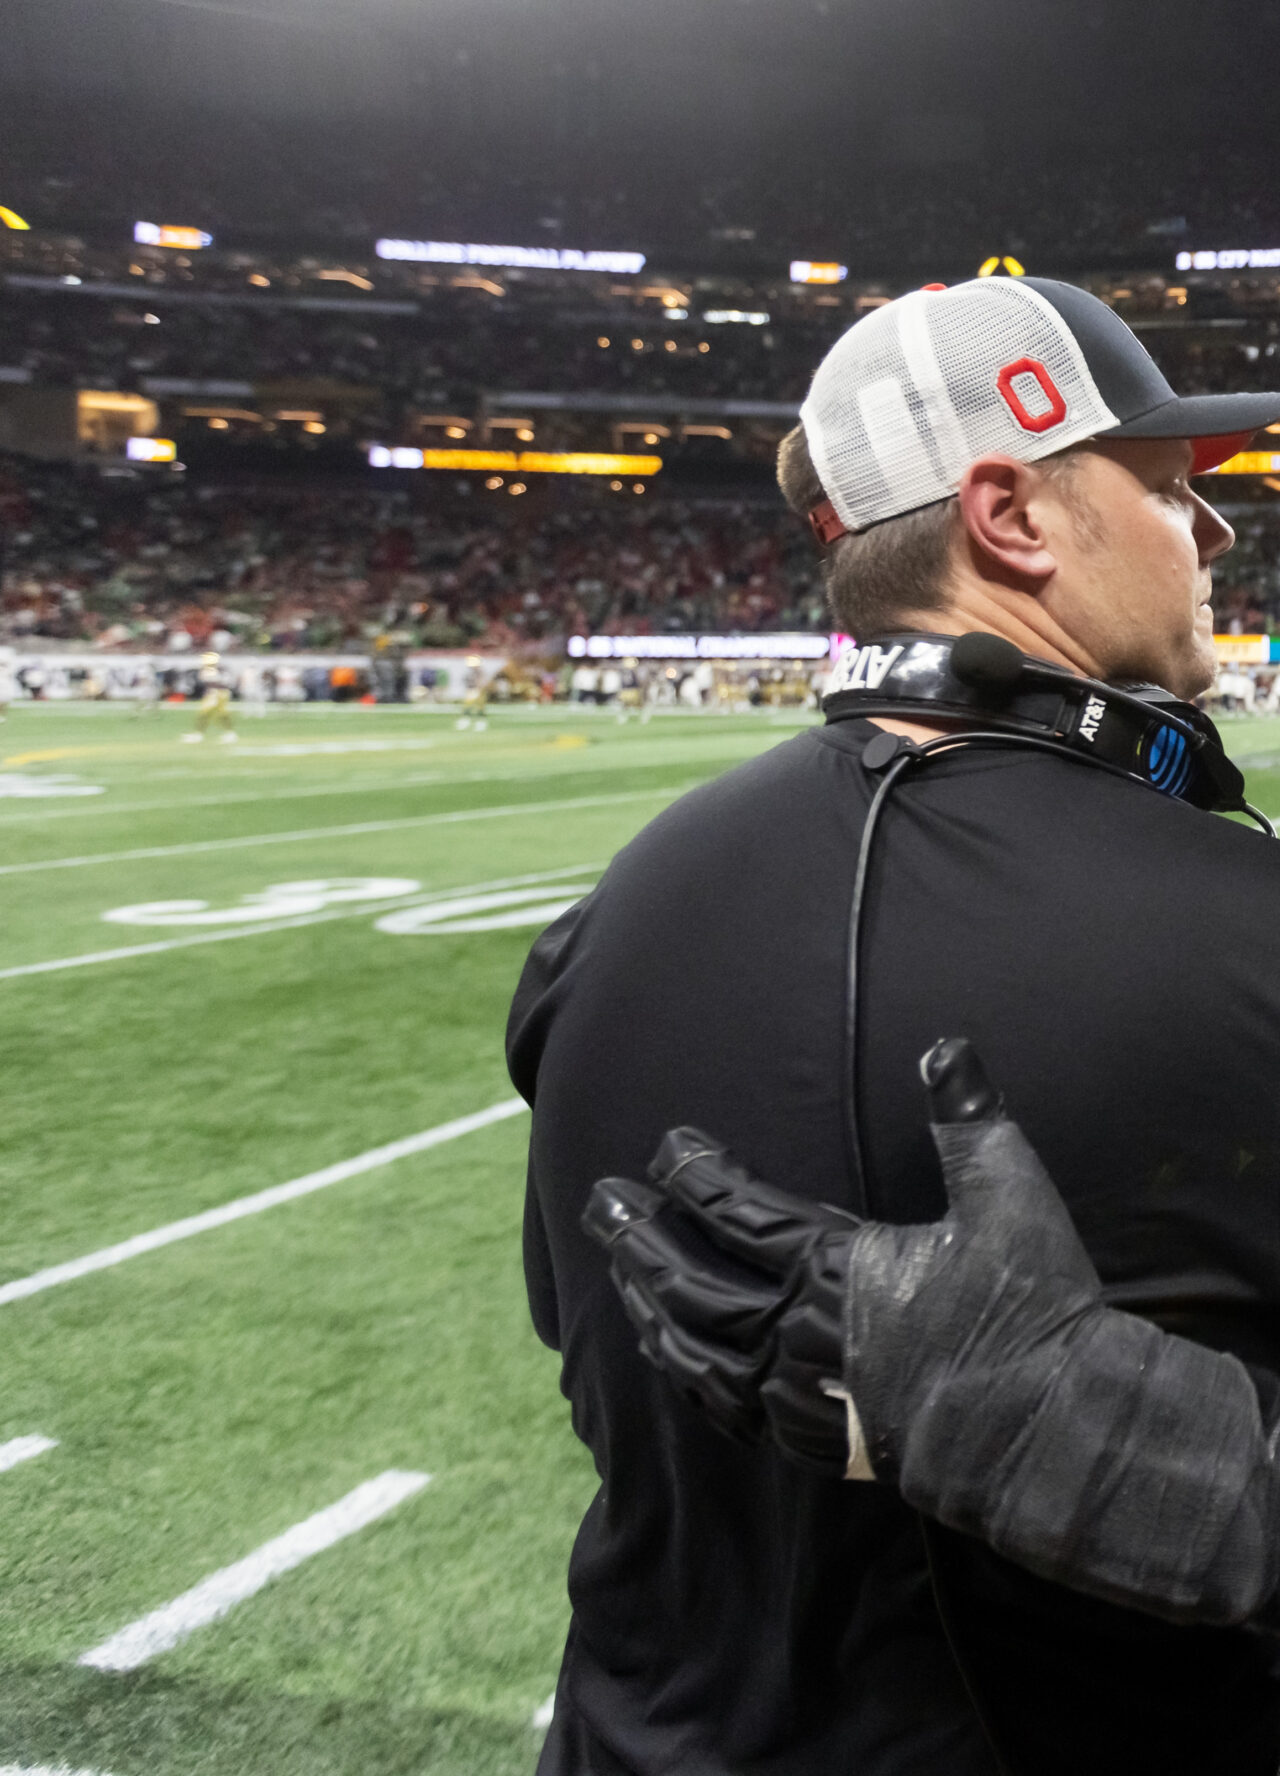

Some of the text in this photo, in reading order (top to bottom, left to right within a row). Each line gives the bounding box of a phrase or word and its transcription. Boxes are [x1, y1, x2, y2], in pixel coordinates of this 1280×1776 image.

[995, 355, 1067, 434] O
[821, 644, 905, 698] AT&
[1079, 693, 1107, 742] AT&T
